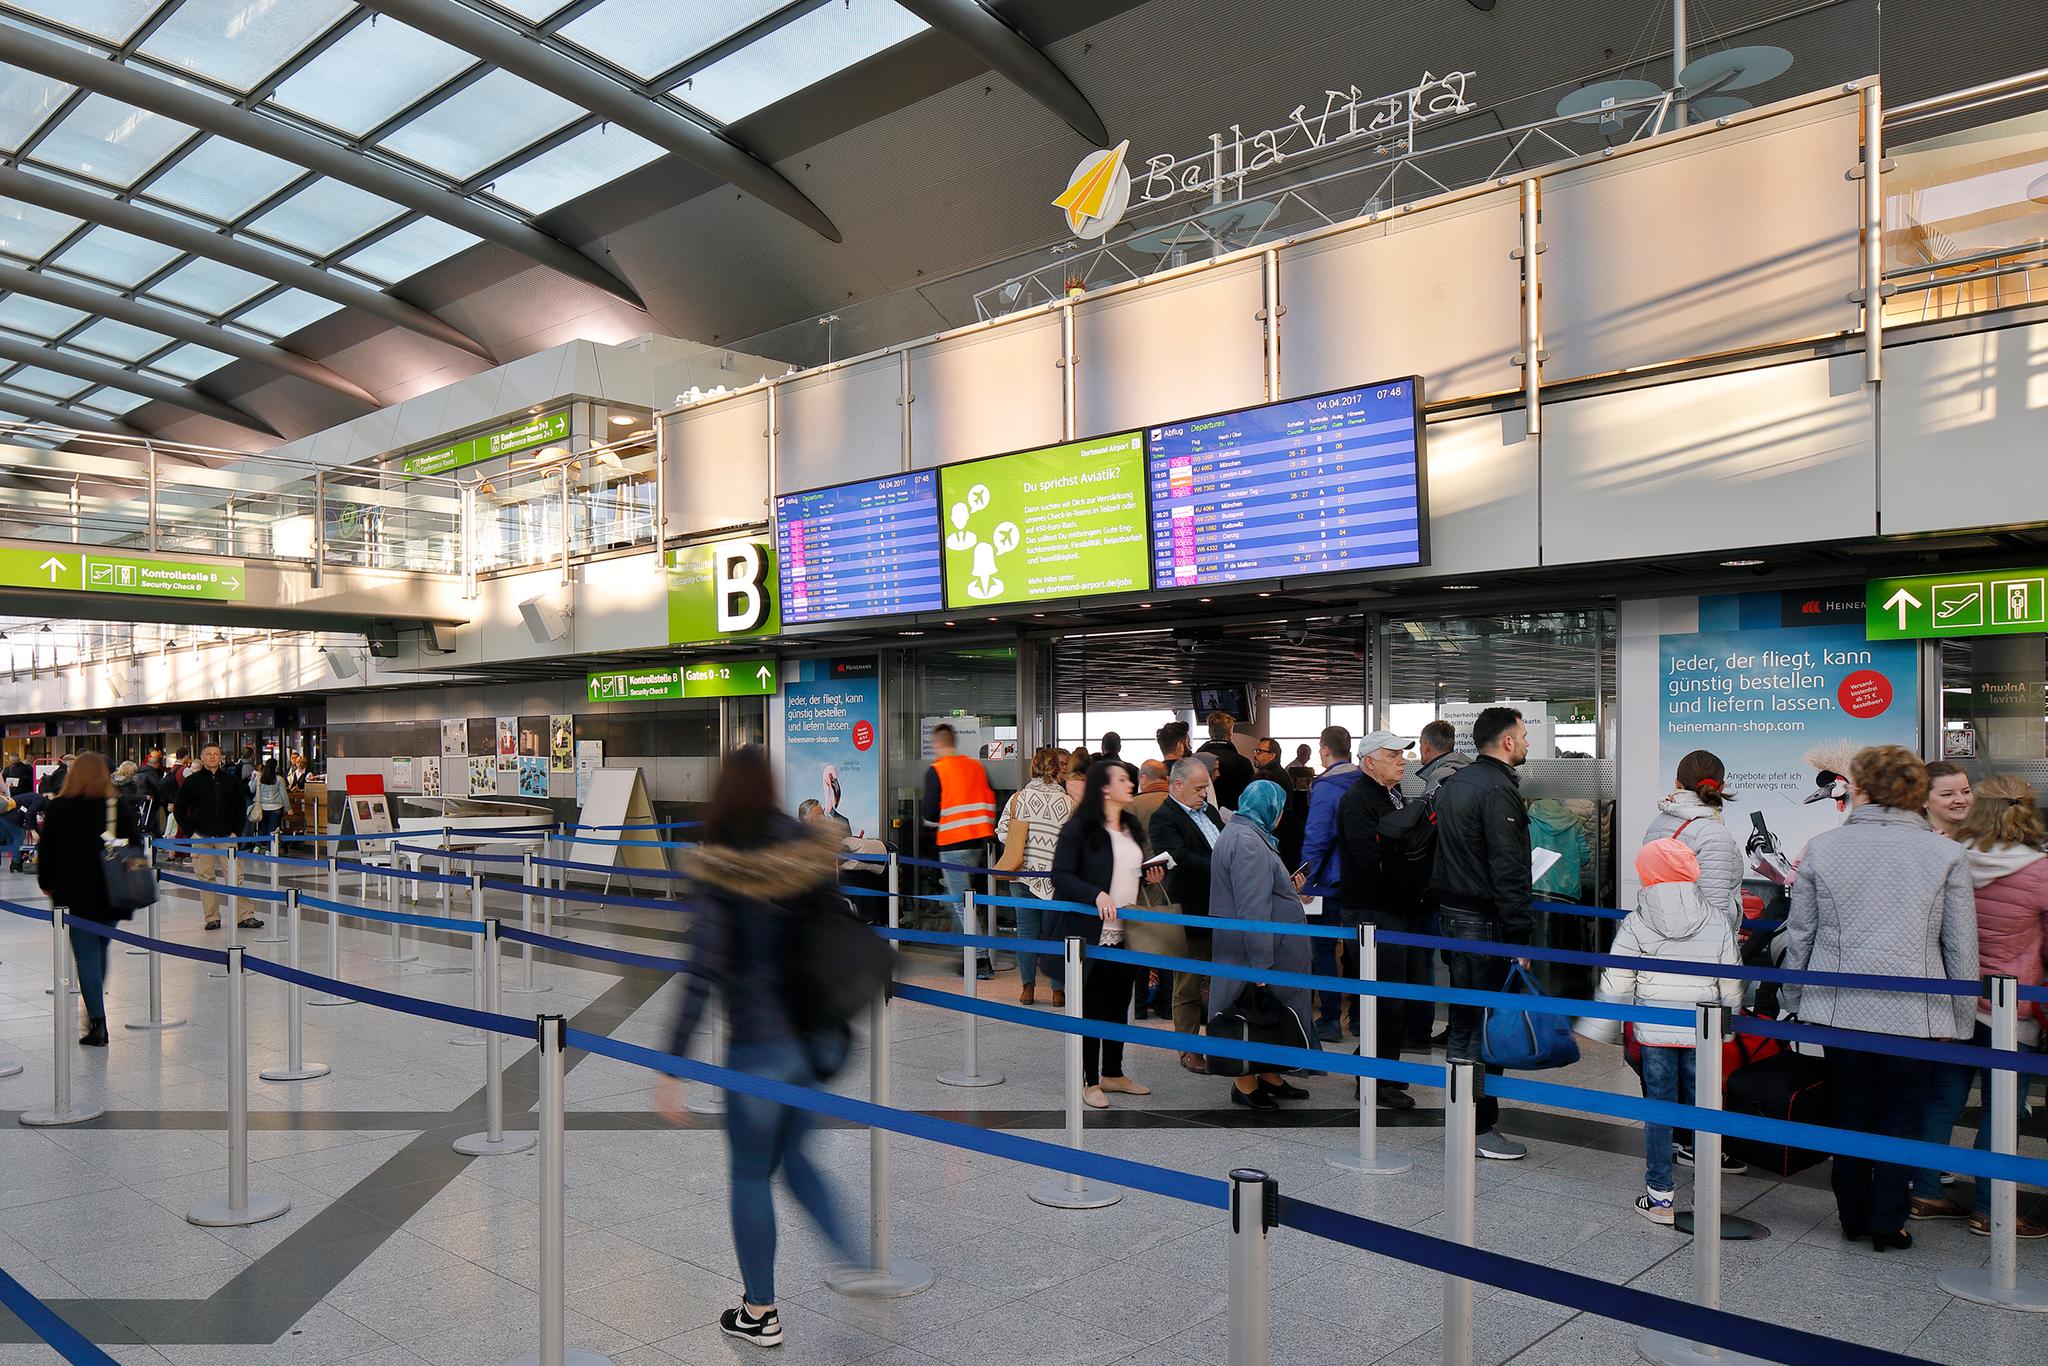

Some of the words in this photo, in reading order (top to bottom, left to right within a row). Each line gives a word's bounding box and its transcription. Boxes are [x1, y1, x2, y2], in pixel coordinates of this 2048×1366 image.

[1316, 394, 1362, 410] 04.04.2017
[1376, 387, 1401, 400] 07:48
[538, 421, 549, 431] 2+3
[1164, 428, 1184, 437] Abflug
[1190, 420, 1225, 433] Departures
[501, 437, 527, 450] Conference
[528, 432, 543, 444] Rooms
[544, 429, 554, 438] 2+3
[1081, 447, 1108, 457] Dortmund
[1109, 443, 1129, 453] Airport
[421, 461, 442, 472] Conference
[879, 479, 906, 490] 04.04.2017
[914, 475, 929, 484] 07:48
[1024, 482, 1037, 493] Du
[1039, 475, 1078, 493] sprichst
[1080, 467, 1120, 484] Aviatik?
[1072, 498, 1085, 506] Dich
[1097, 492, 1133, 502] Verstärkung
[1100, 503, 1120, 512] Teilzeit
[1122, 501, 1136, 510] oder
[1038, 534, 1057, 543] solltest
[1068, 529, 1102, 539] mitbringen:
[1104, 534, 1143, 544] Belastbarkeit
[142, 568, 209, 581] Kontrollstelle
[211, 574, 217, 582] B
[141, 581, 172, 590] Security
[717, 542, 764, 632] B
[1028, 578, 1132, 594] www.dortmund-airport.de/jobs
[1826, 601, 1866, 610] HEINEM
[1669, 655, 1720, 674] Jeder,
[1726, 652, 1755, 669] der
[1762, 650, 1816, 670] fliegt,
[1824, 649, 1871, 666] kann
[630, 674, 672, 685] Kontrollstelle
[673, 674, 678, 682] B
[686, 669, 706, 681] Gates
[708, 670, 714, 680] 0
[720, 669, 730, 679] 12
[1669, 677, 1732, 697] günstig
[1740, 672, 1825, 691] bestellen
[1850, 680, 1874, 689] Versand-
[1851, 686, 1878, 696] kostenfrei
[630, 688, 649, 697] Security
[788, 696, 807, 707] Jeder,
[809, 694, 821, 705] der
[823, 694, 843, 706] fliegt,
[845, 693, 863, 703] kann
[1669, 698, 1700, 714] und
[1708, 696, 1764, 712] liefern
[1772, 693, 1836, 711] lassen.
[1852, 698, 1883, 710] Bestellwert
[788, 708, 812, 720] günstig
[815, 707, 846, 717] bestellen
[789, 721, 800, 731] und
[803, 721, 824, 731] liefern
[827, 720, 850, 730] lassen.
[1669, 719, 1805, 734] heinemann-shop.com
[788, 736, 839, 744] heinemann-shop.com
[1727, 772, 1765, 781] Angebote
[1769, 772, 1787, 781] pfeif
[1735, 782, 1778, 791] unterwegs
